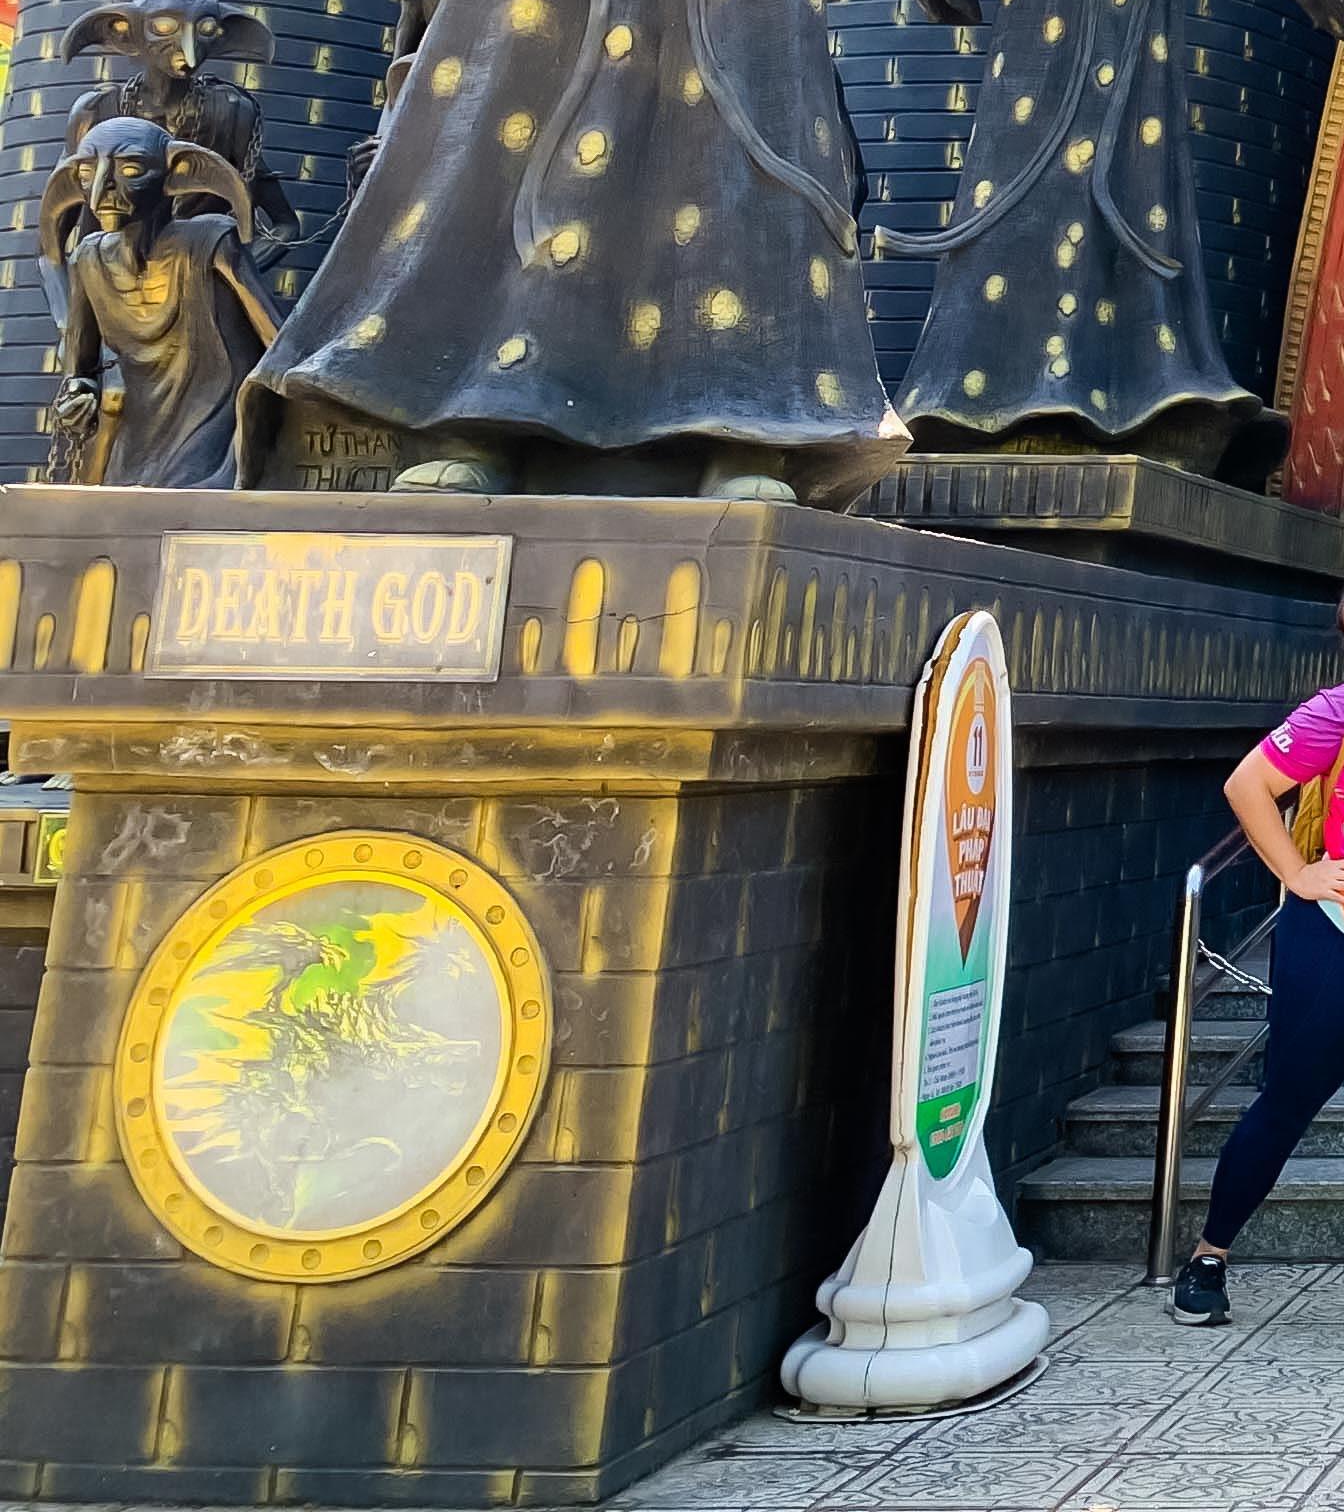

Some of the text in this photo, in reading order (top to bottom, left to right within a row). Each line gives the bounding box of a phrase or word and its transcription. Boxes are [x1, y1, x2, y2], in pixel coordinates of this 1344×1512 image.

[175, 568, 483, 644] DEATH GOD
[973, 725, 983, 767] 11
